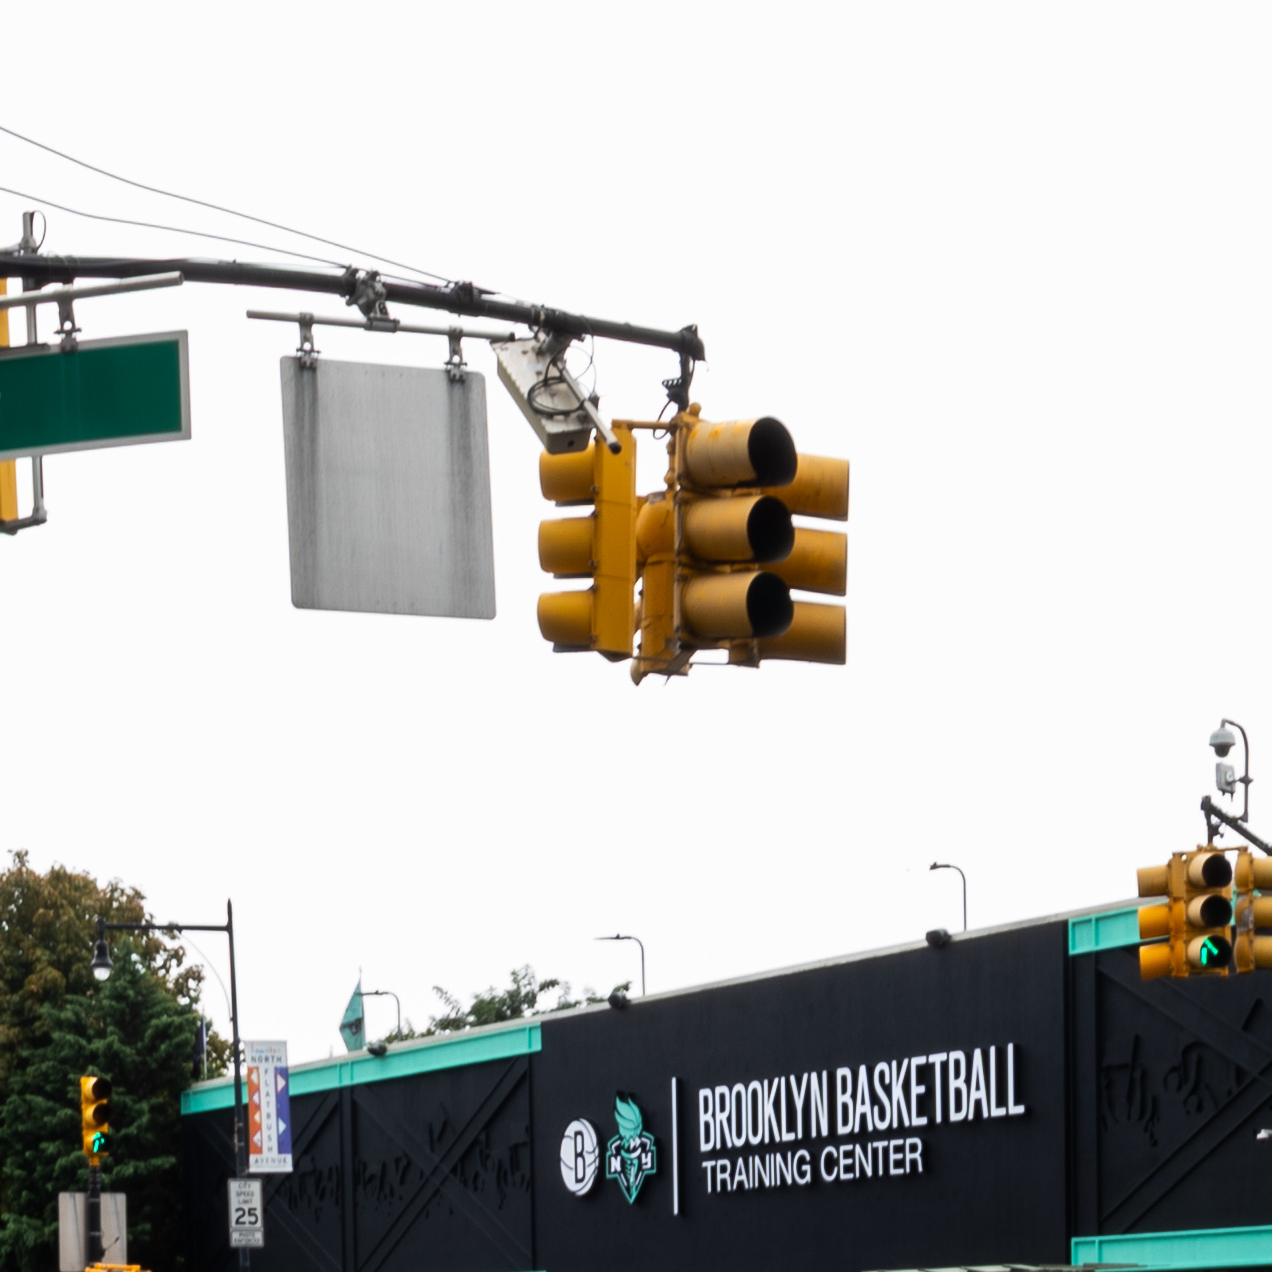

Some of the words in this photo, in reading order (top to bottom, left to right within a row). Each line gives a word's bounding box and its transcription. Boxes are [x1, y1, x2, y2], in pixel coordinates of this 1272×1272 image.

[251, 1055, 282, 1063] NORTH
[698, 1070, 829, 1152] BROOKLYN
[836, 1042, 1026, 1135] BASKETBALL
[574, 1130, 586, 1184] B
[701, 1148, 812, 1194] TRAINING
[820, 1136, 923, 1182] CENTER
[235, 1207, 259, 1225] 25
